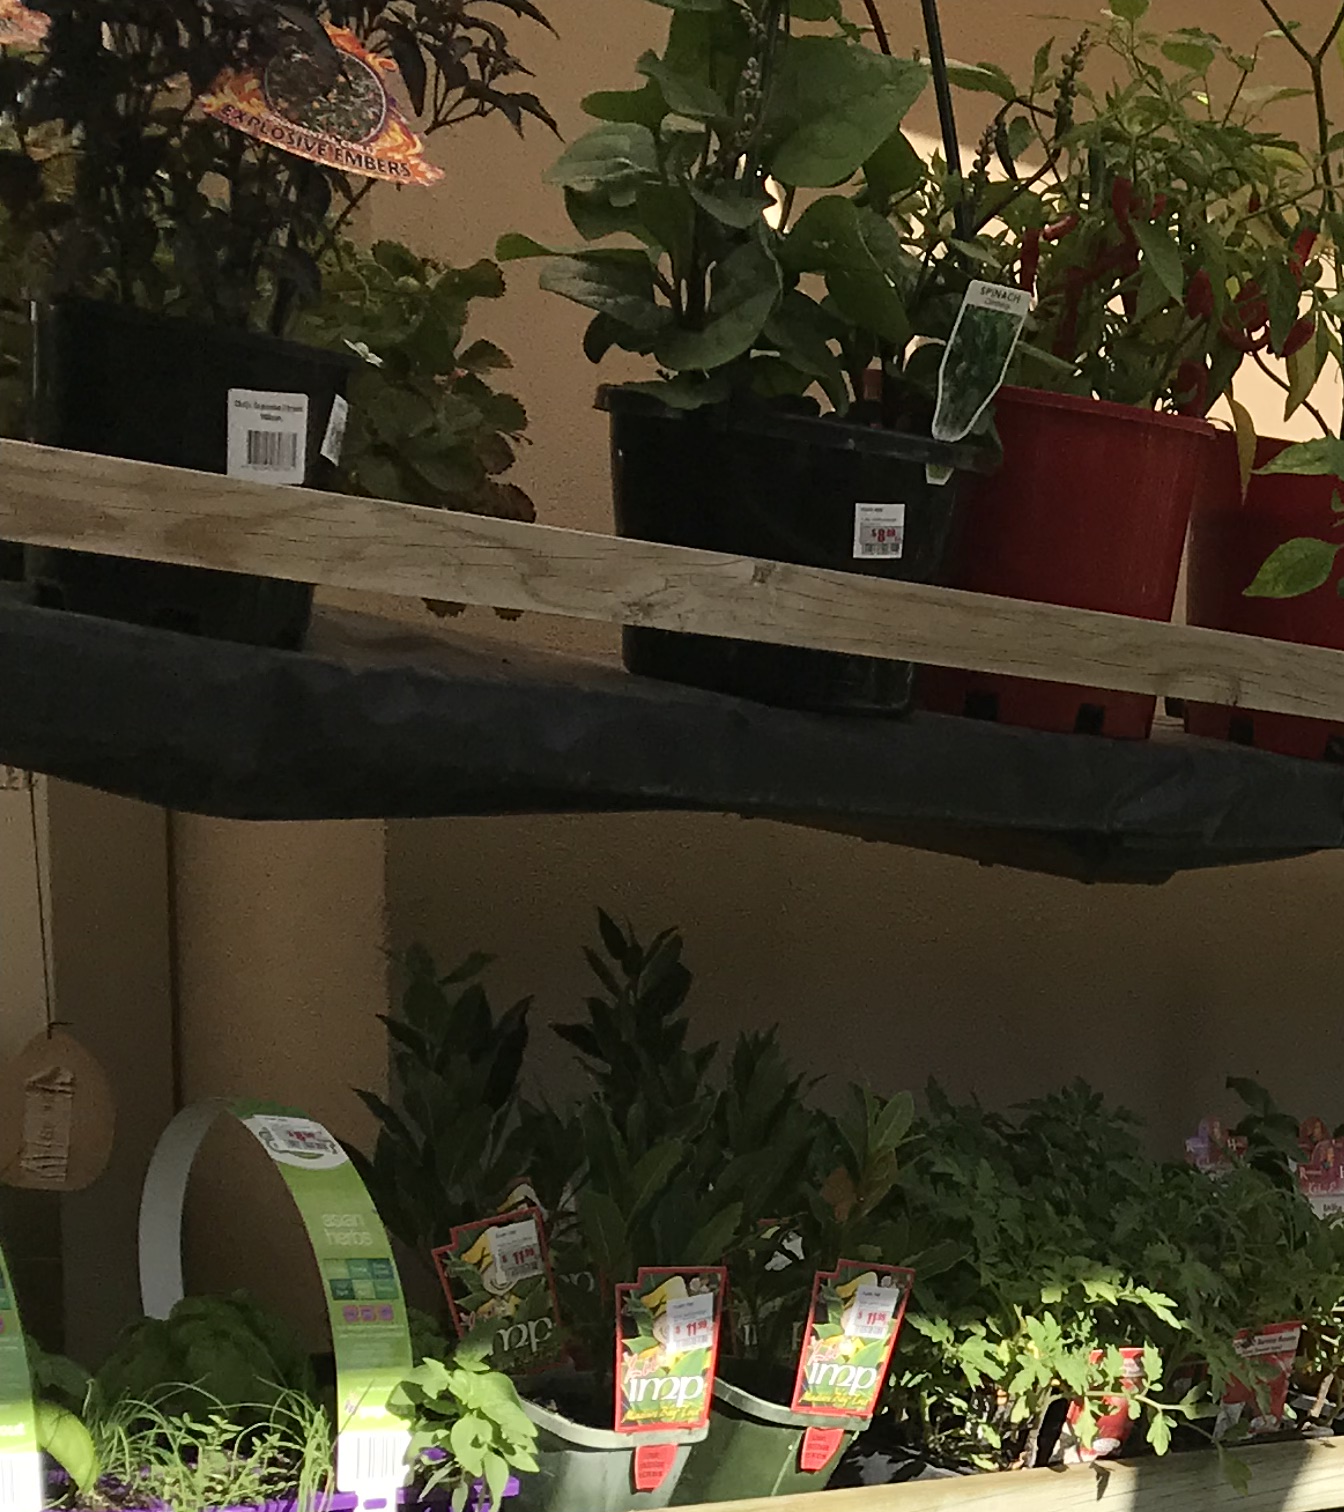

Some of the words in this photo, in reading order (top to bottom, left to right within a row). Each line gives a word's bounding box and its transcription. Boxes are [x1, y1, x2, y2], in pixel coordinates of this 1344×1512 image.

[220, 103, 327, 157] EXPLOSIVE
[333, 147, 412, 178] EMBERS
[980, 285, 1022, 304] SPINACH
[628, 1375, 704, 1409] imp
[808, 1361, 877, 1397] imp
